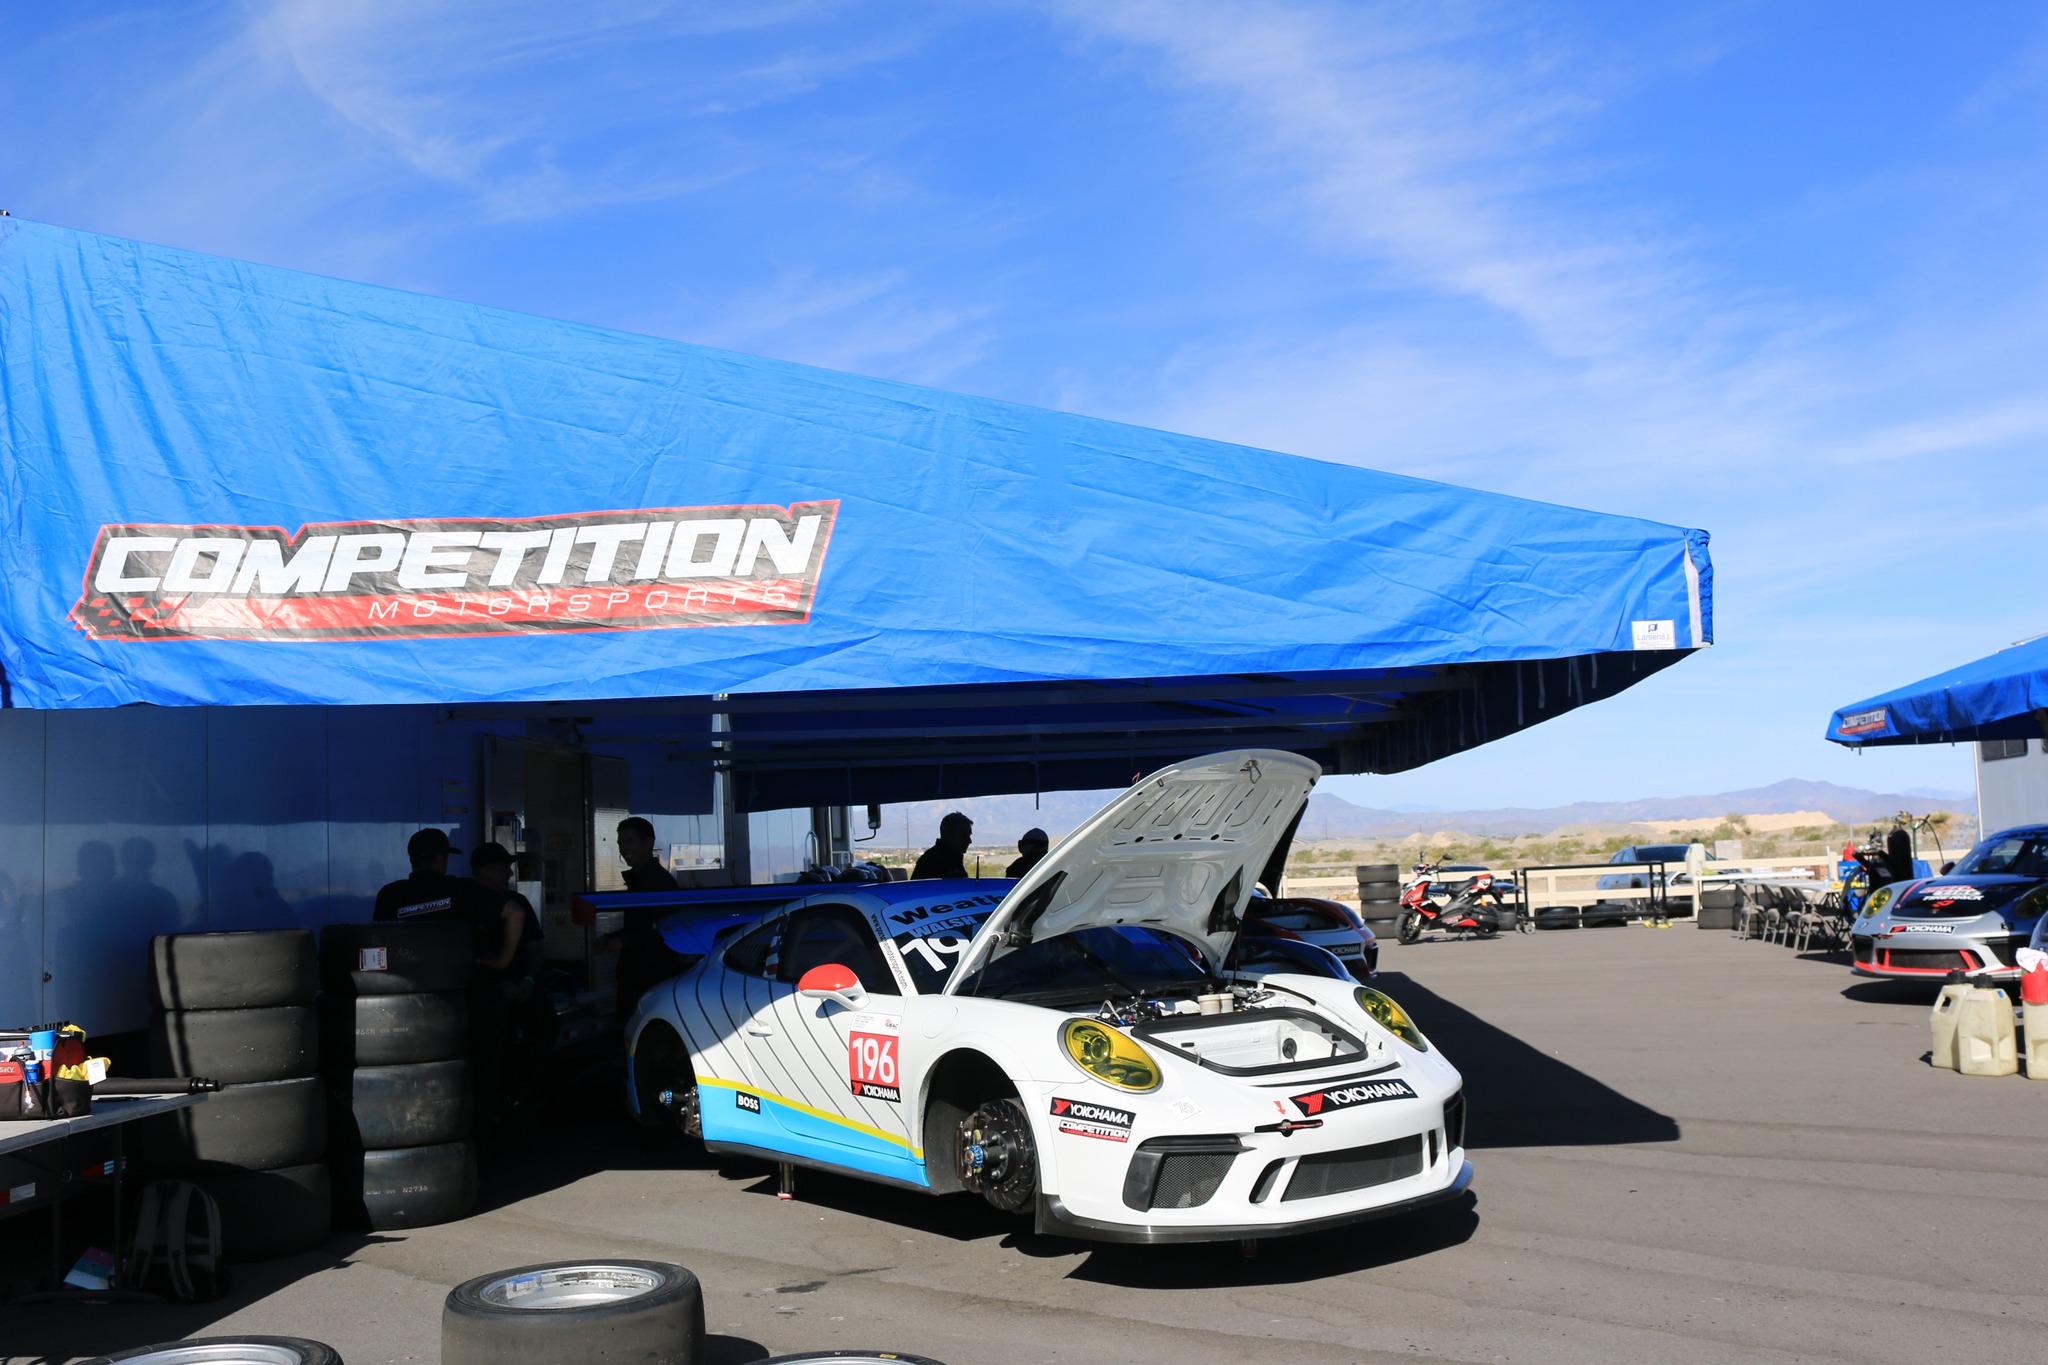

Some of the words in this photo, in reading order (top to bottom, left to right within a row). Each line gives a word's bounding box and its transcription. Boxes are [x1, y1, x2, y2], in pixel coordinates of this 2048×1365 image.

[95, 515, 822, 592] COMPETITION
[368, 586, 787, 618] MOTORSPORTS
[908, 915, 978, 938] WALSH
[1906, 925, 1953, 933] YOKOHAMA
[1331, 945, 1360, 954] YOKOHAMA
[852, 1037, 895, 1084] 196
[738, 1094, 759, 1110] BOSS
[863, 1085, 900, 1101] YOKOHAMA
[1324, 1082, 1412, 1105] YOKOHAMA
[1070, 1103, 1130, 1125] YOKOHAMA
[1060, 1120, 1130, 1138] COMPETITION
